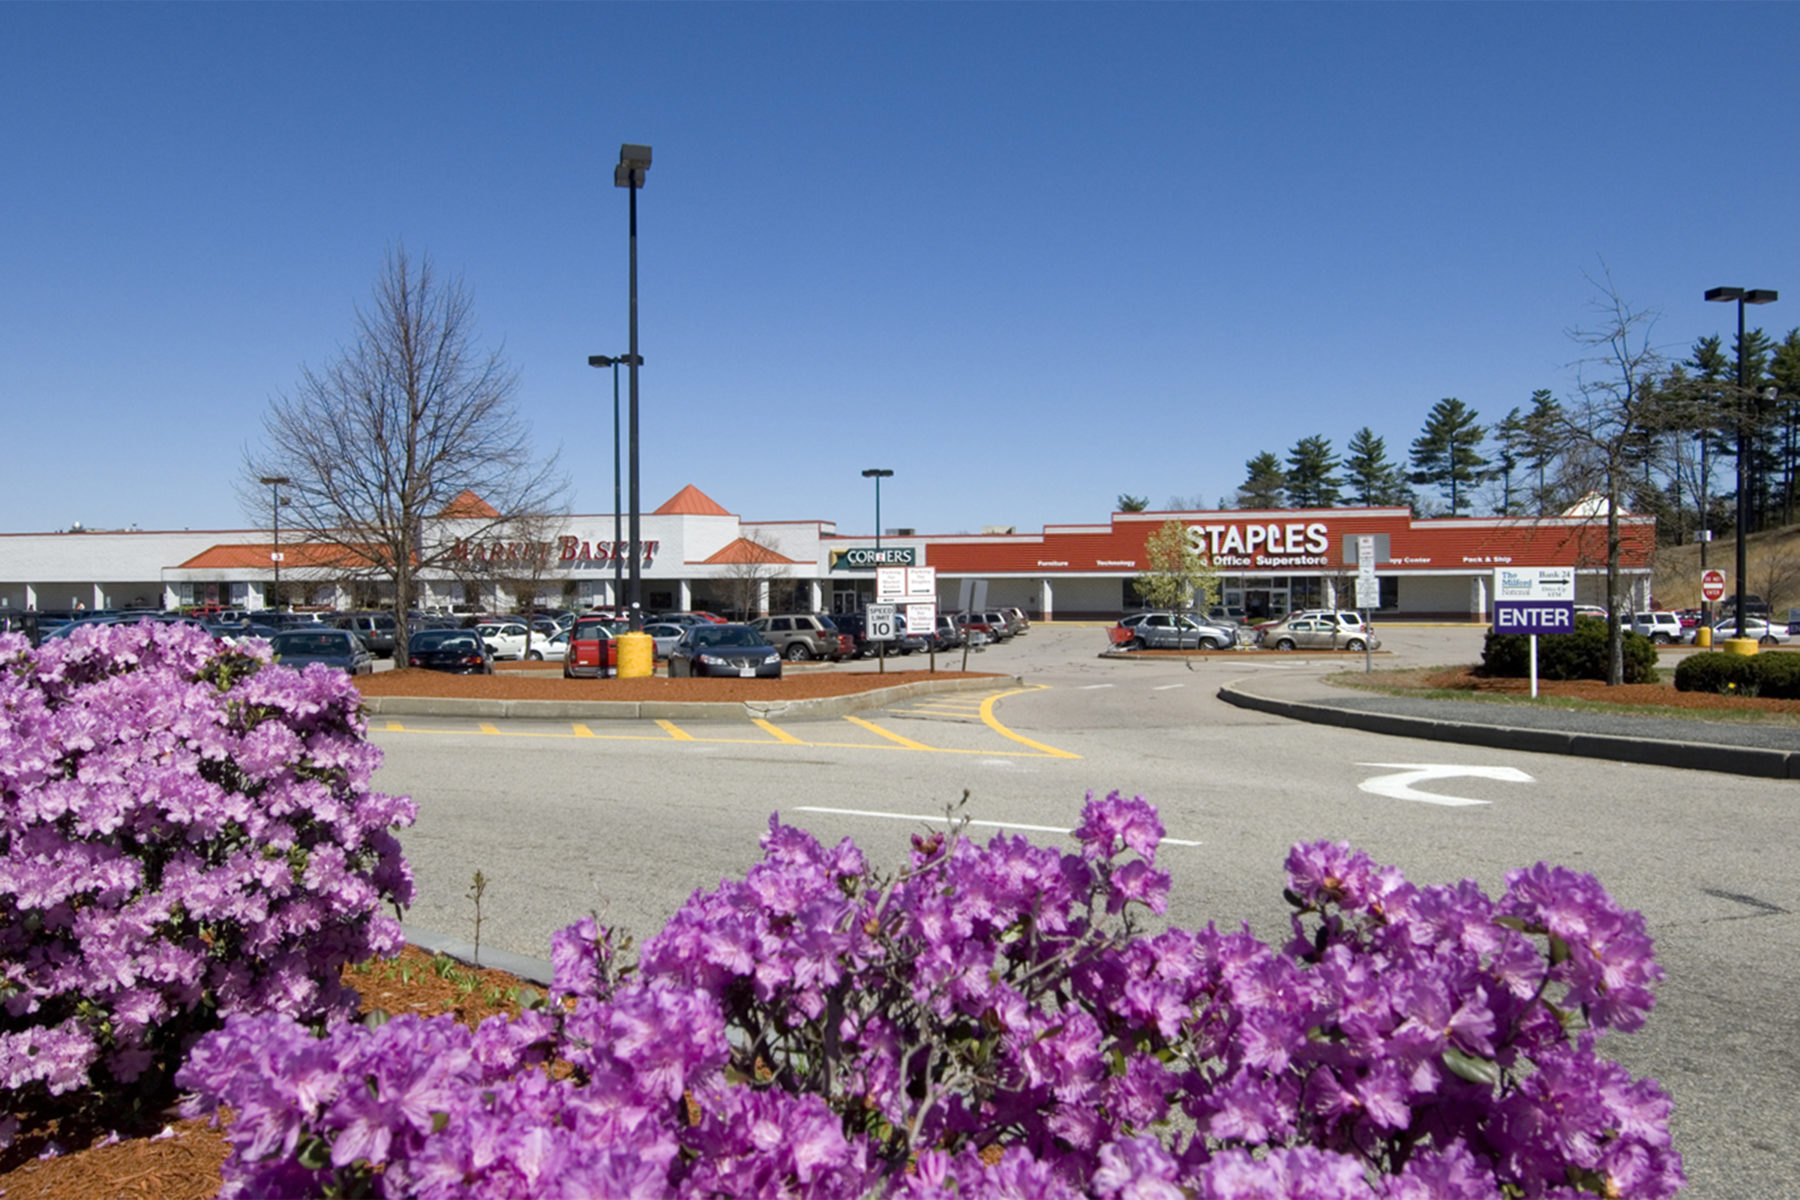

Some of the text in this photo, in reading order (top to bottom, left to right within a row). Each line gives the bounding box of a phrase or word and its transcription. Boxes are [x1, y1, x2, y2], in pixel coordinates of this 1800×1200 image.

[1187, 523, 1329, 554] STAPLES
[558, 535, 659, 561] BASKT
[1213, 555, 1251, 566] Office
[1256, 555, 1329, 567] Superstore
[1502, 579, 1532, 587] Milford
[1499, 608, 1570, 626] ENTER
[873, 622, 890, 636] 10
